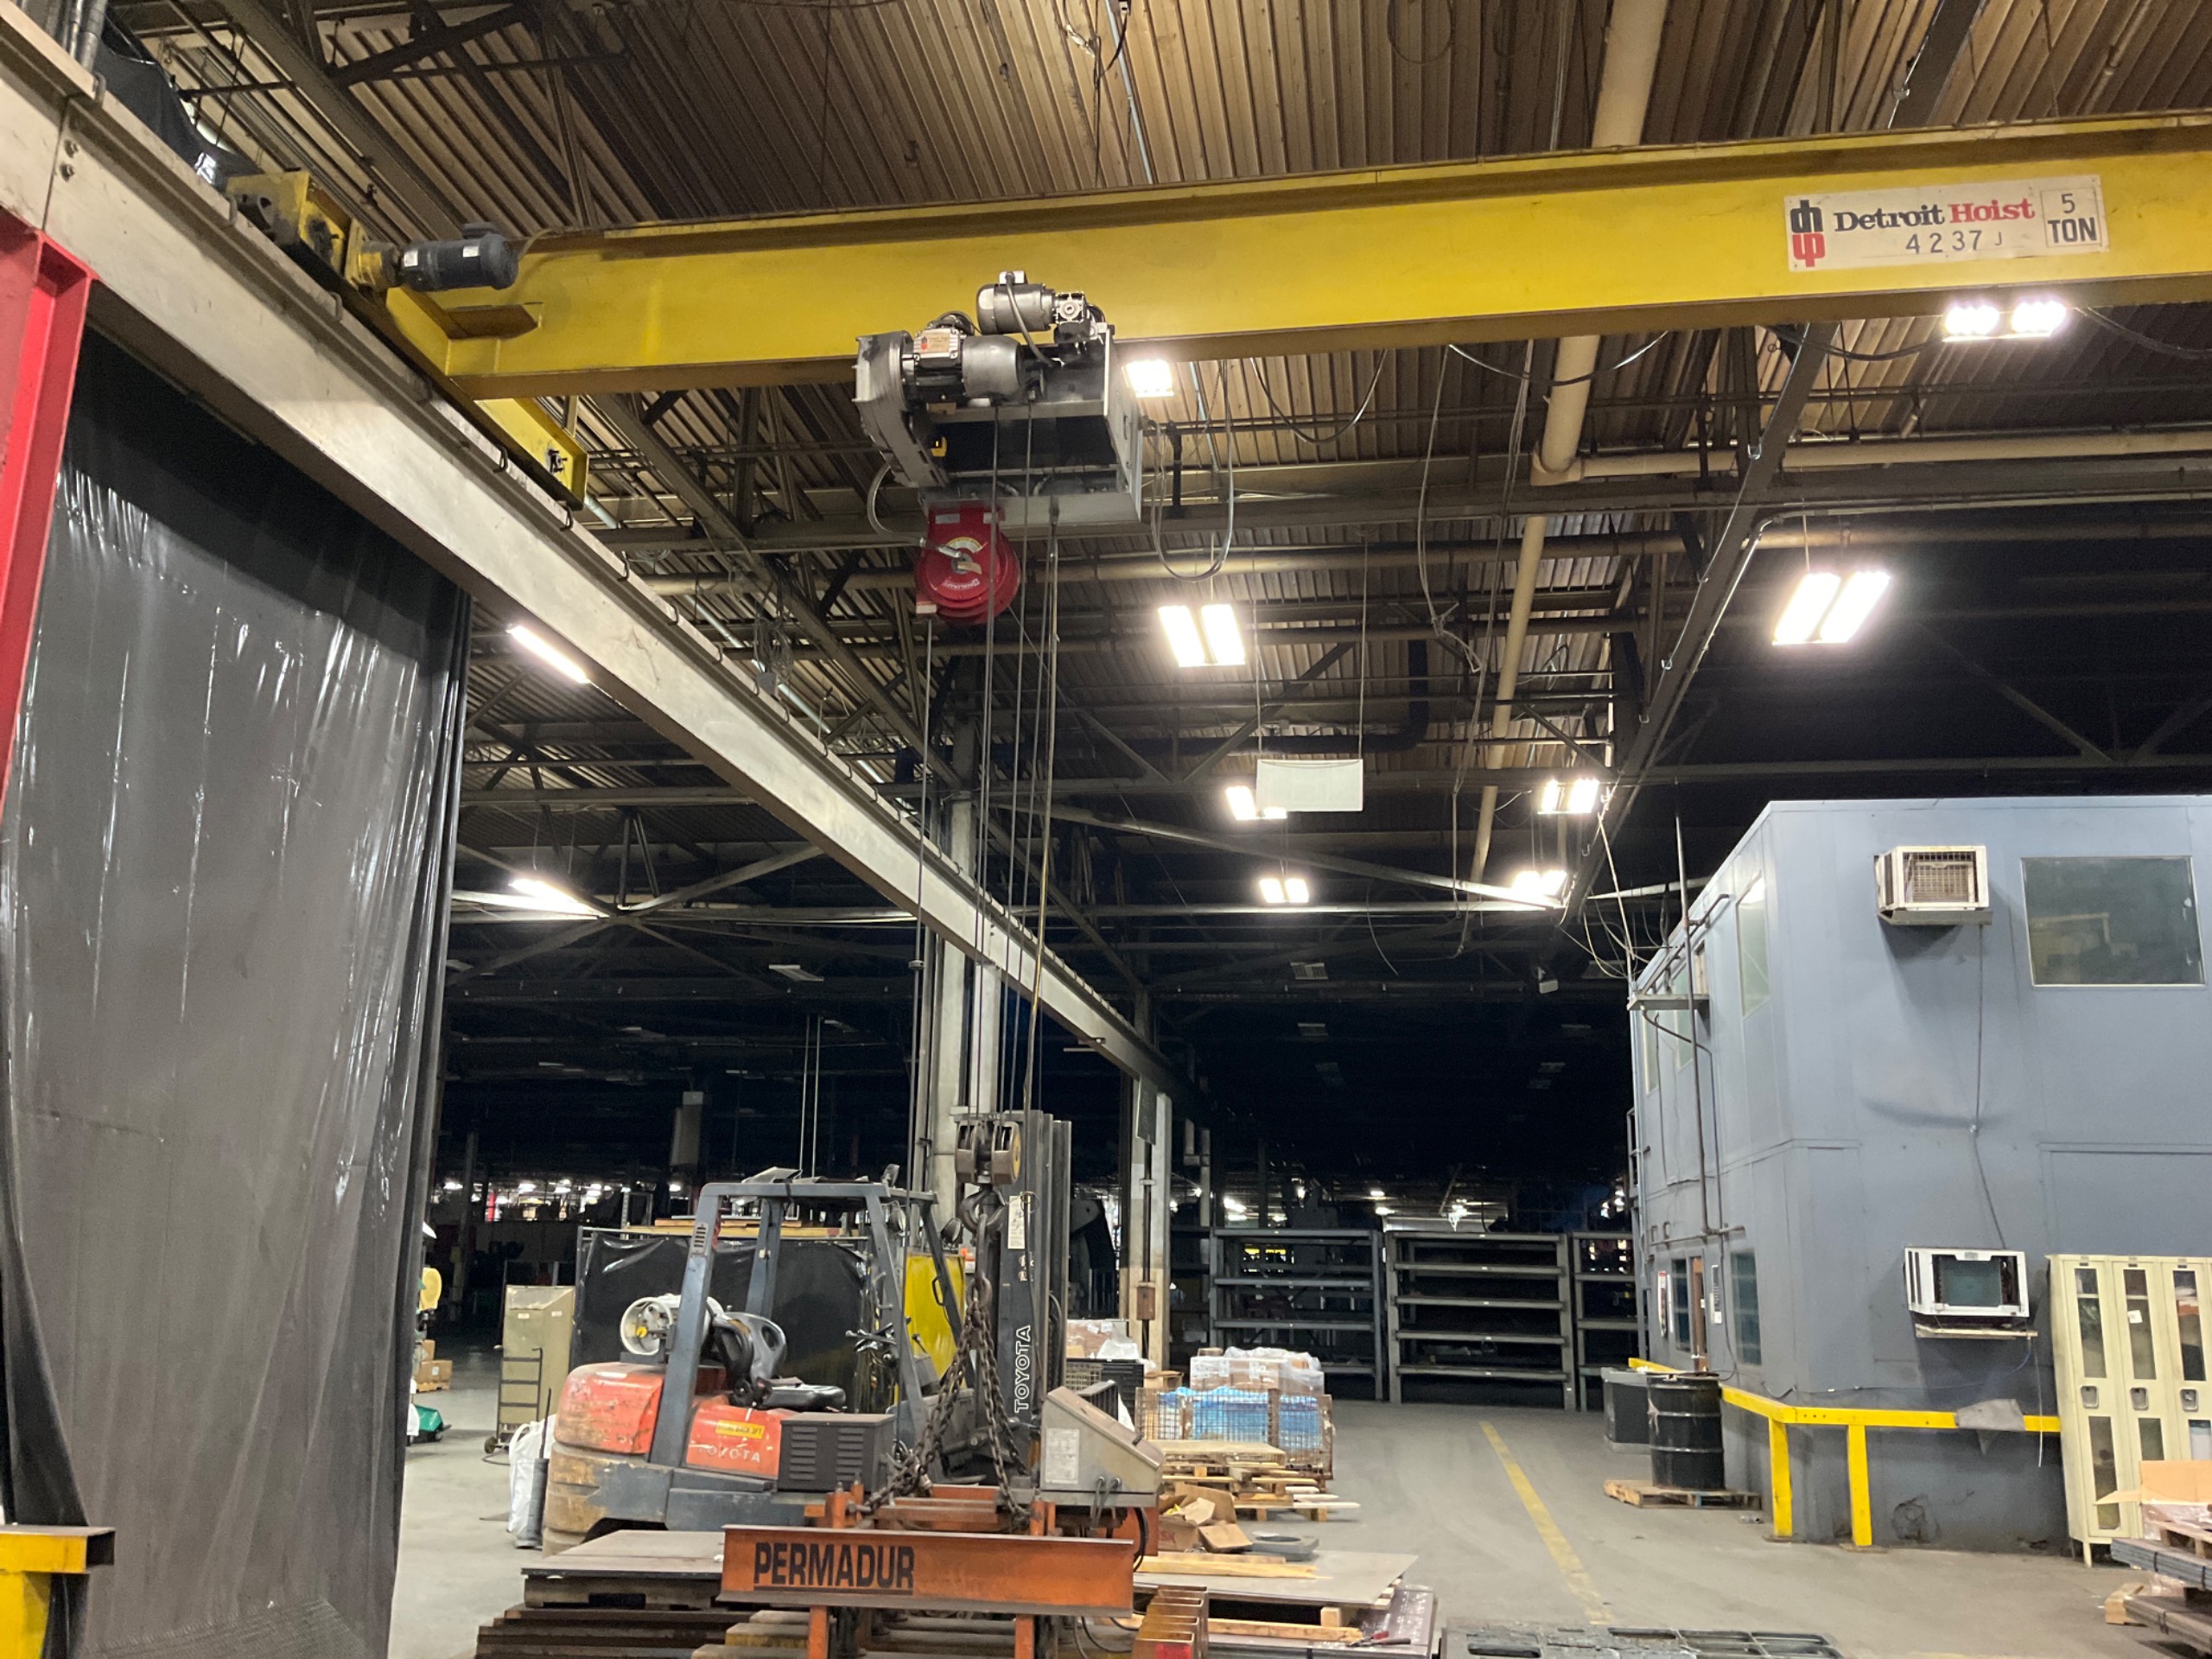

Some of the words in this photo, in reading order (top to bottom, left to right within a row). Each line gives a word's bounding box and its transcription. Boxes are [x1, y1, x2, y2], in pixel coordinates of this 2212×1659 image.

[1834, 204, 1945, 232] Detroit
[1948, 198, 2035, 223] Hoist
[2062, 193, 2075, 213] 5
[2048, 217, 2098, 244] TON
[1014, 1325, 1032, 1414] TOYOTA
[698, 1446, 760, 1463] OYOTA
[753, 1541, 915, 1588] PERMADUR
